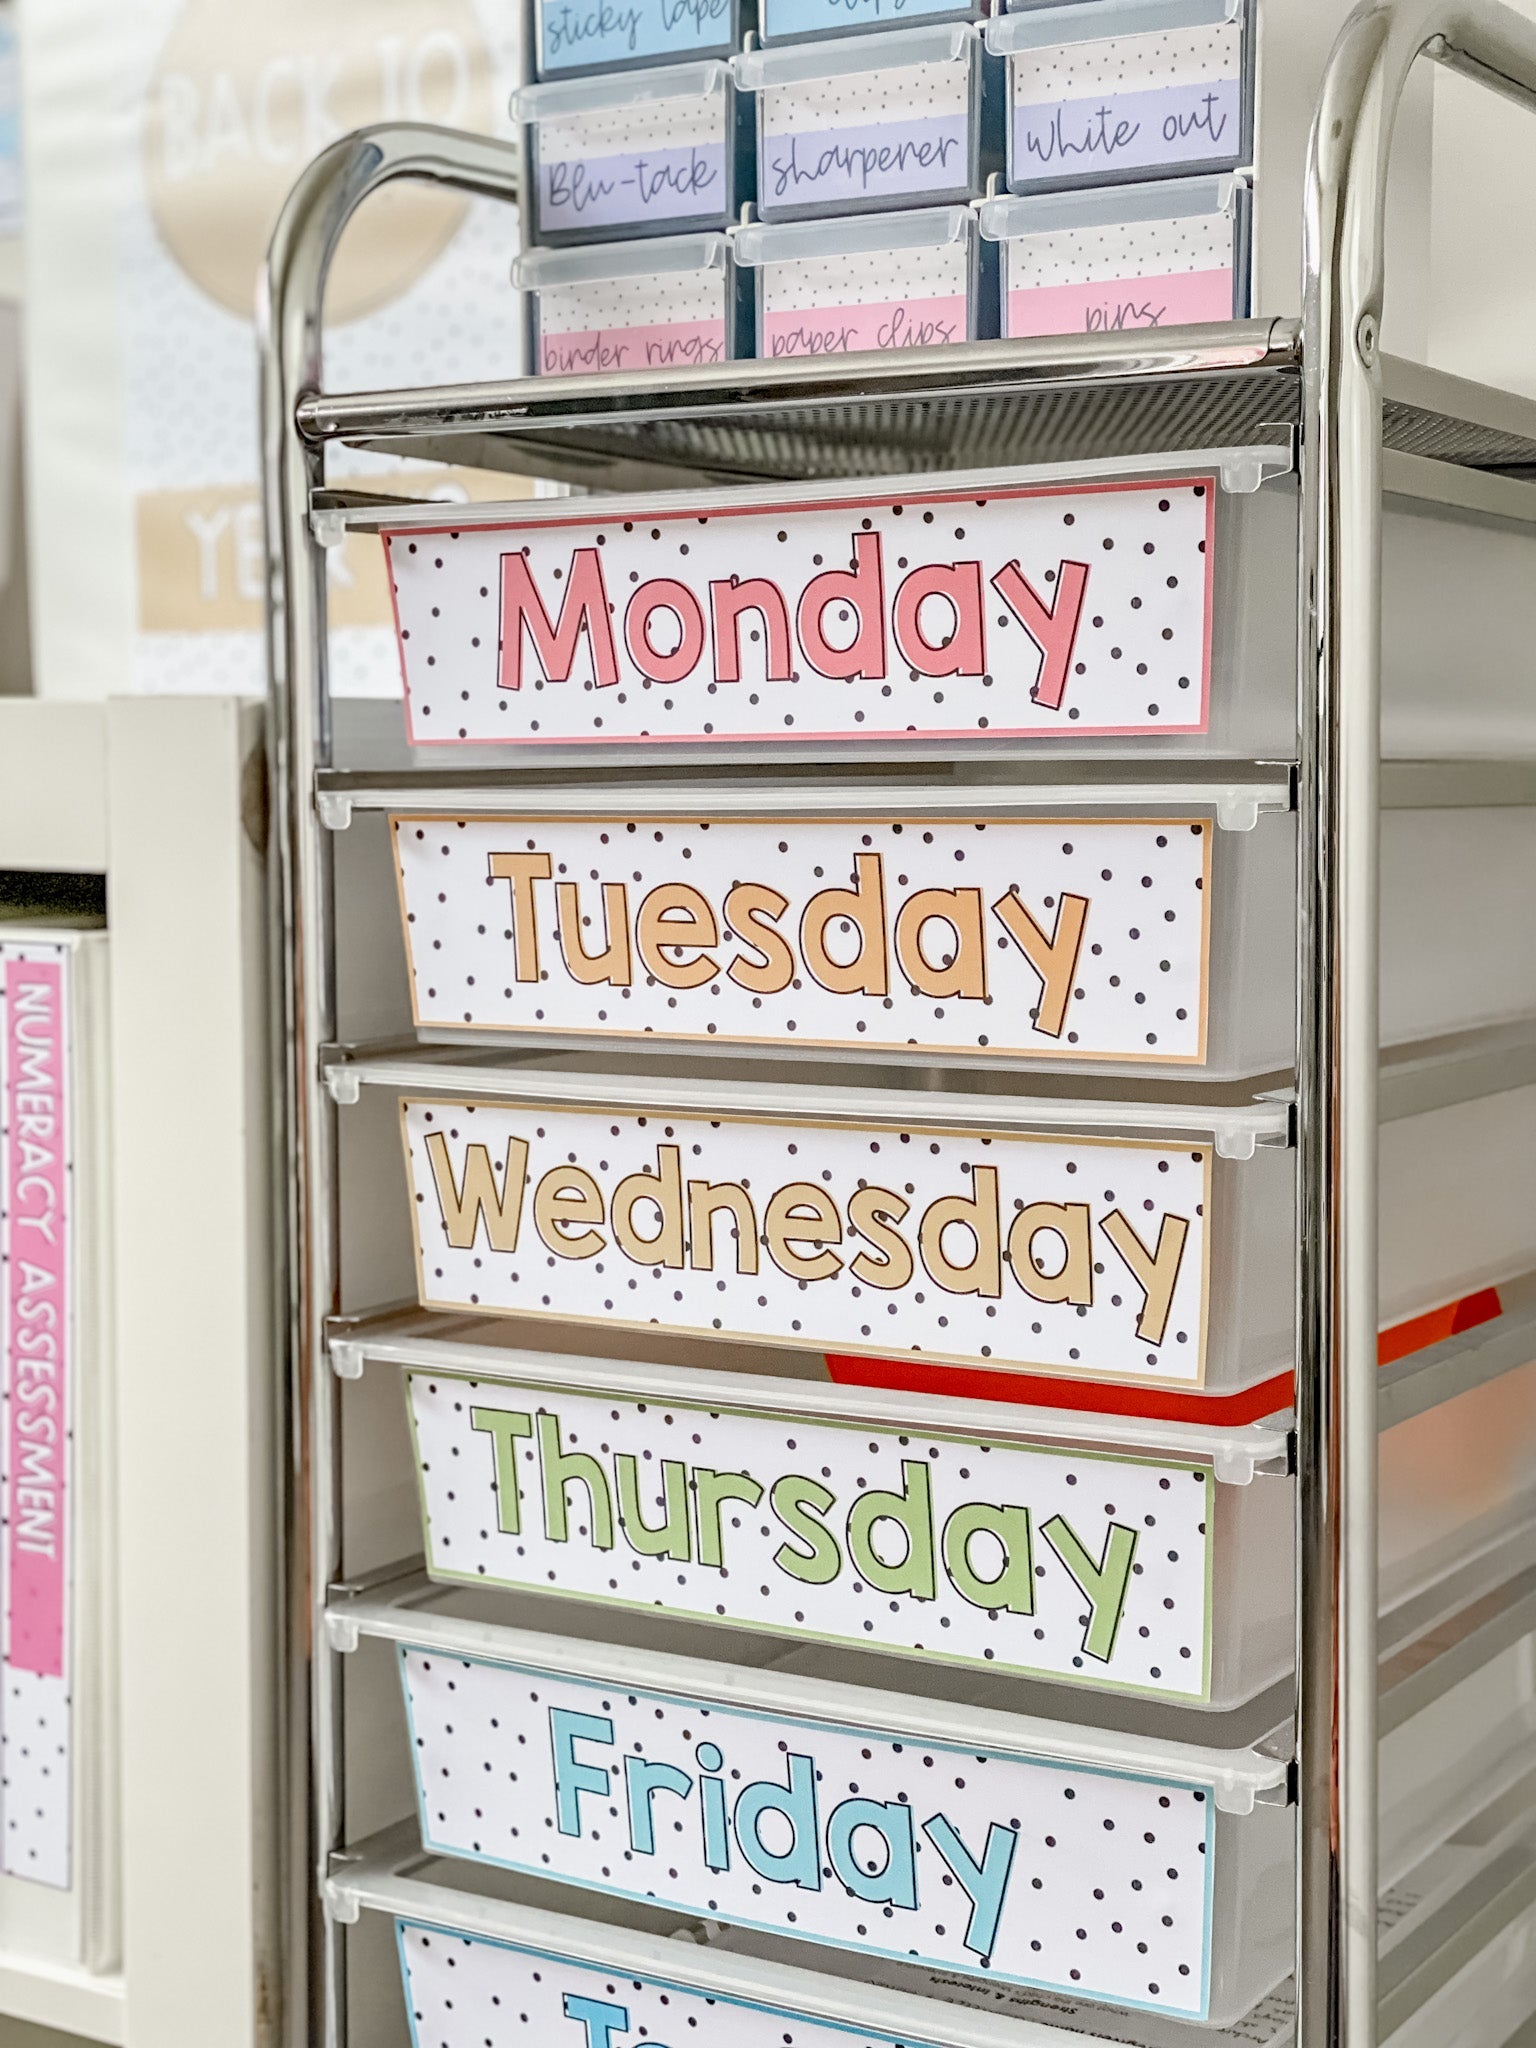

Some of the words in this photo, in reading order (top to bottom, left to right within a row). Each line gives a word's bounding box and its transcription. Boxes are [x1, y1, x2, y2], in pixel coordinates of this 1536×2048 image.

[547, 0, 643, 54] sticky
[158, 52, 352, 180] BACK
[549, 148, 718, 211] Blu-tack
[772, 134, 959, 196] sharpener
[1027, 105, 1140, 161] white
[1163, 92, 1227, 142] out
[544, 332, 630, 373] binder
[646, 335, 724, 365] rings
[772, 326, 858, 357] paper
[877, 307, 956, 348] clips
[1086, 301, 1167, 332] pins
[496, 531, 1091, 711] Monday
[487, 852, 1090, 1038] Tuesday
[14, 983, 56, 1245] NUMERACY
[424, 1132, 1190, 1346] Wednesday
[15, 1250, 57, 1561] ASSESSMENT
[470, 1406, 1141, 1663] Thursday
[548, 1707, 1019, 1958] Friday
